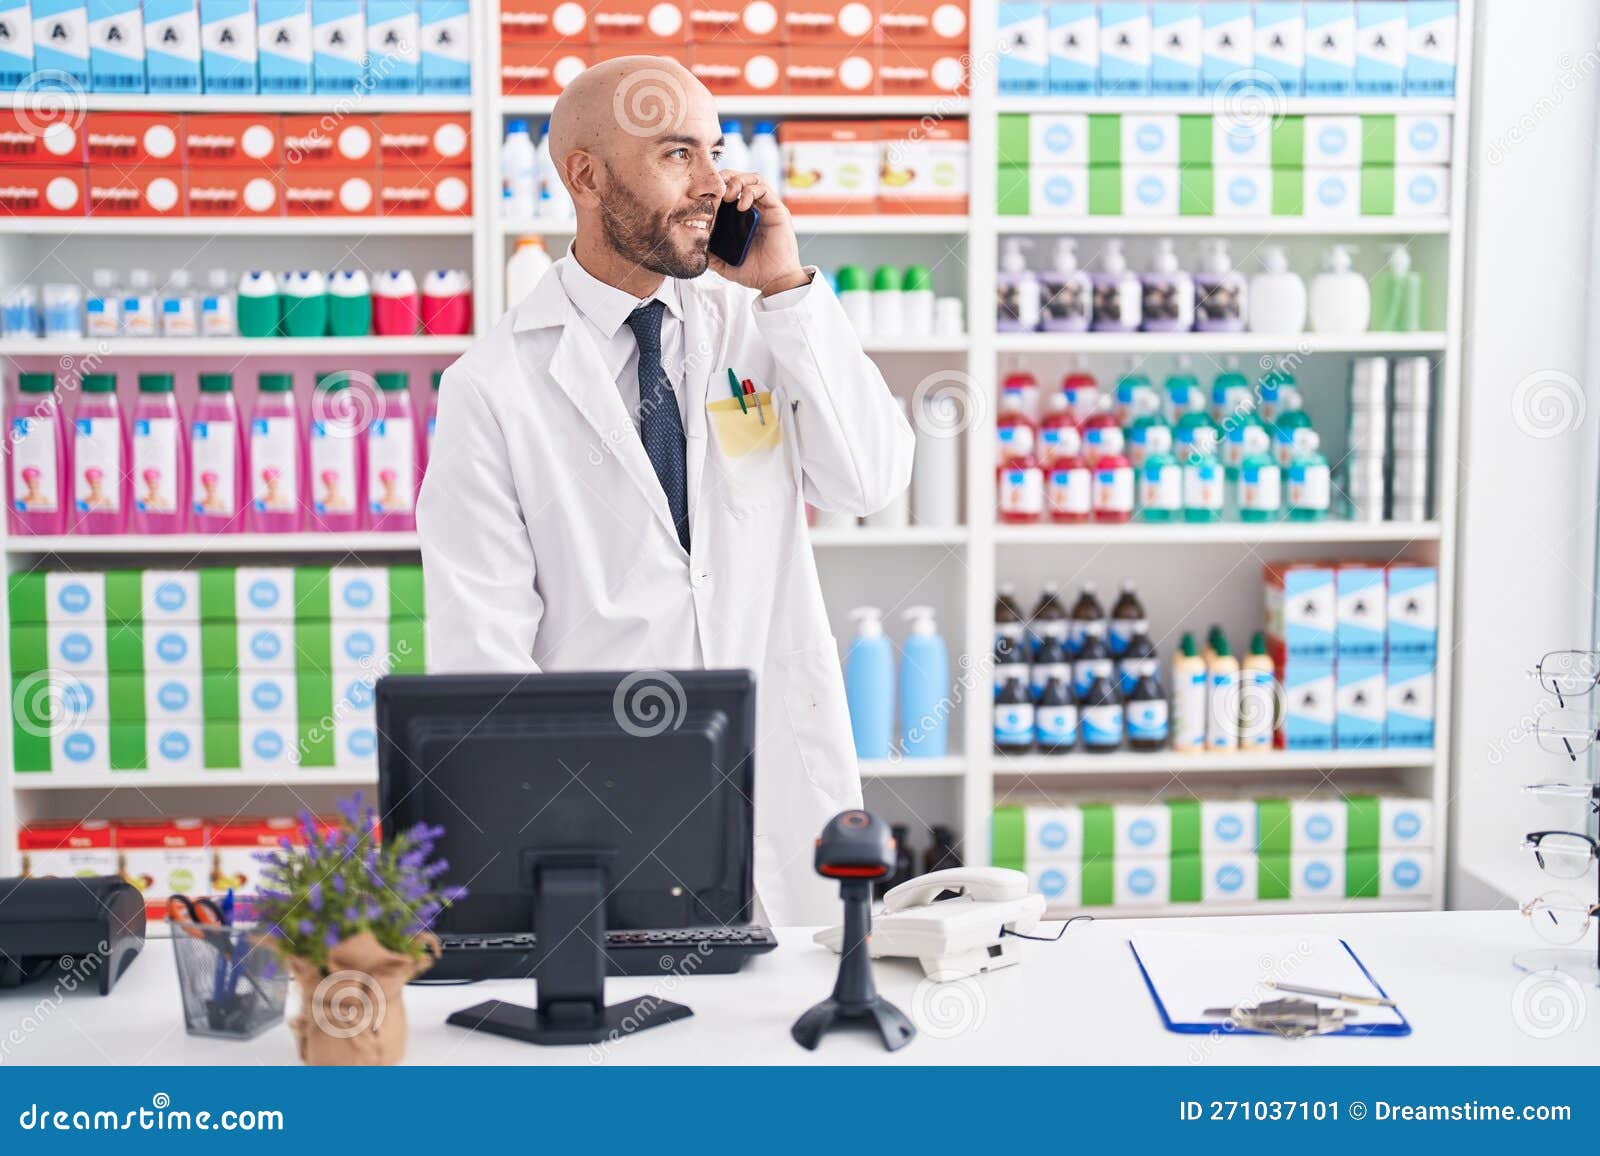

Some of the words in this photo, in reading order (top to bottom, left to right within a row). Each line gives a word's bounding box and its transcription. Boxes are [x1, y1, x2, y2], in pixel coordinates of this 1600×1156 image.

[51, 23, 67, 39] A
[107, 25, 123, 41] A
[163, 27, 178, 42] A
[219, 28, 235, 43] A
[275, 29, 290, 44] A
